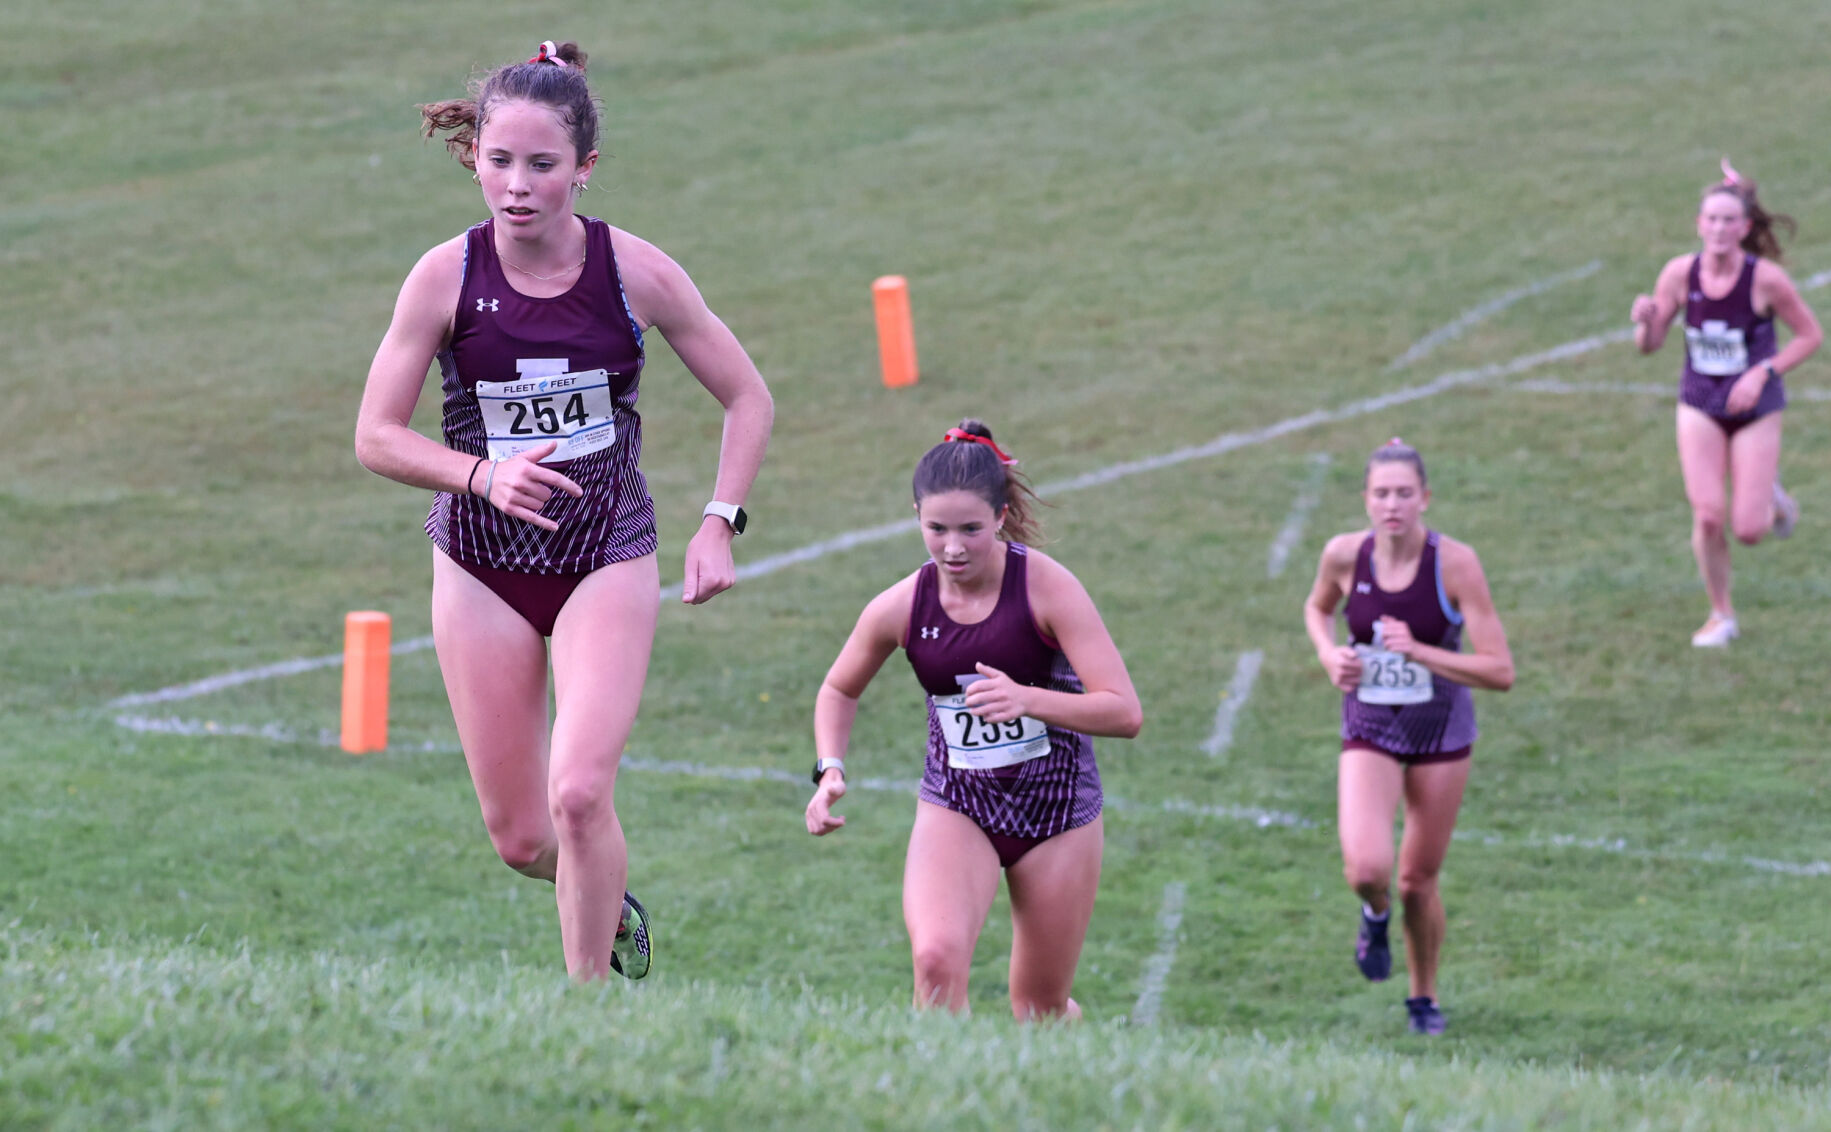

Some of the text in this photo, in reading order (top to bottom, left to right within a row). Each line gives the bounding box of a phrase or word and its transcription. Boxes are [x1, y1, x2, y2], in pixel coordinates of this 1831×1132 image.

[503, 377, 577, 394] FLEET FEET
[503, 392, 590, 435] 254
[1369, 659, 1417, 688] 255
[955, 711, 1025, 747] 259
